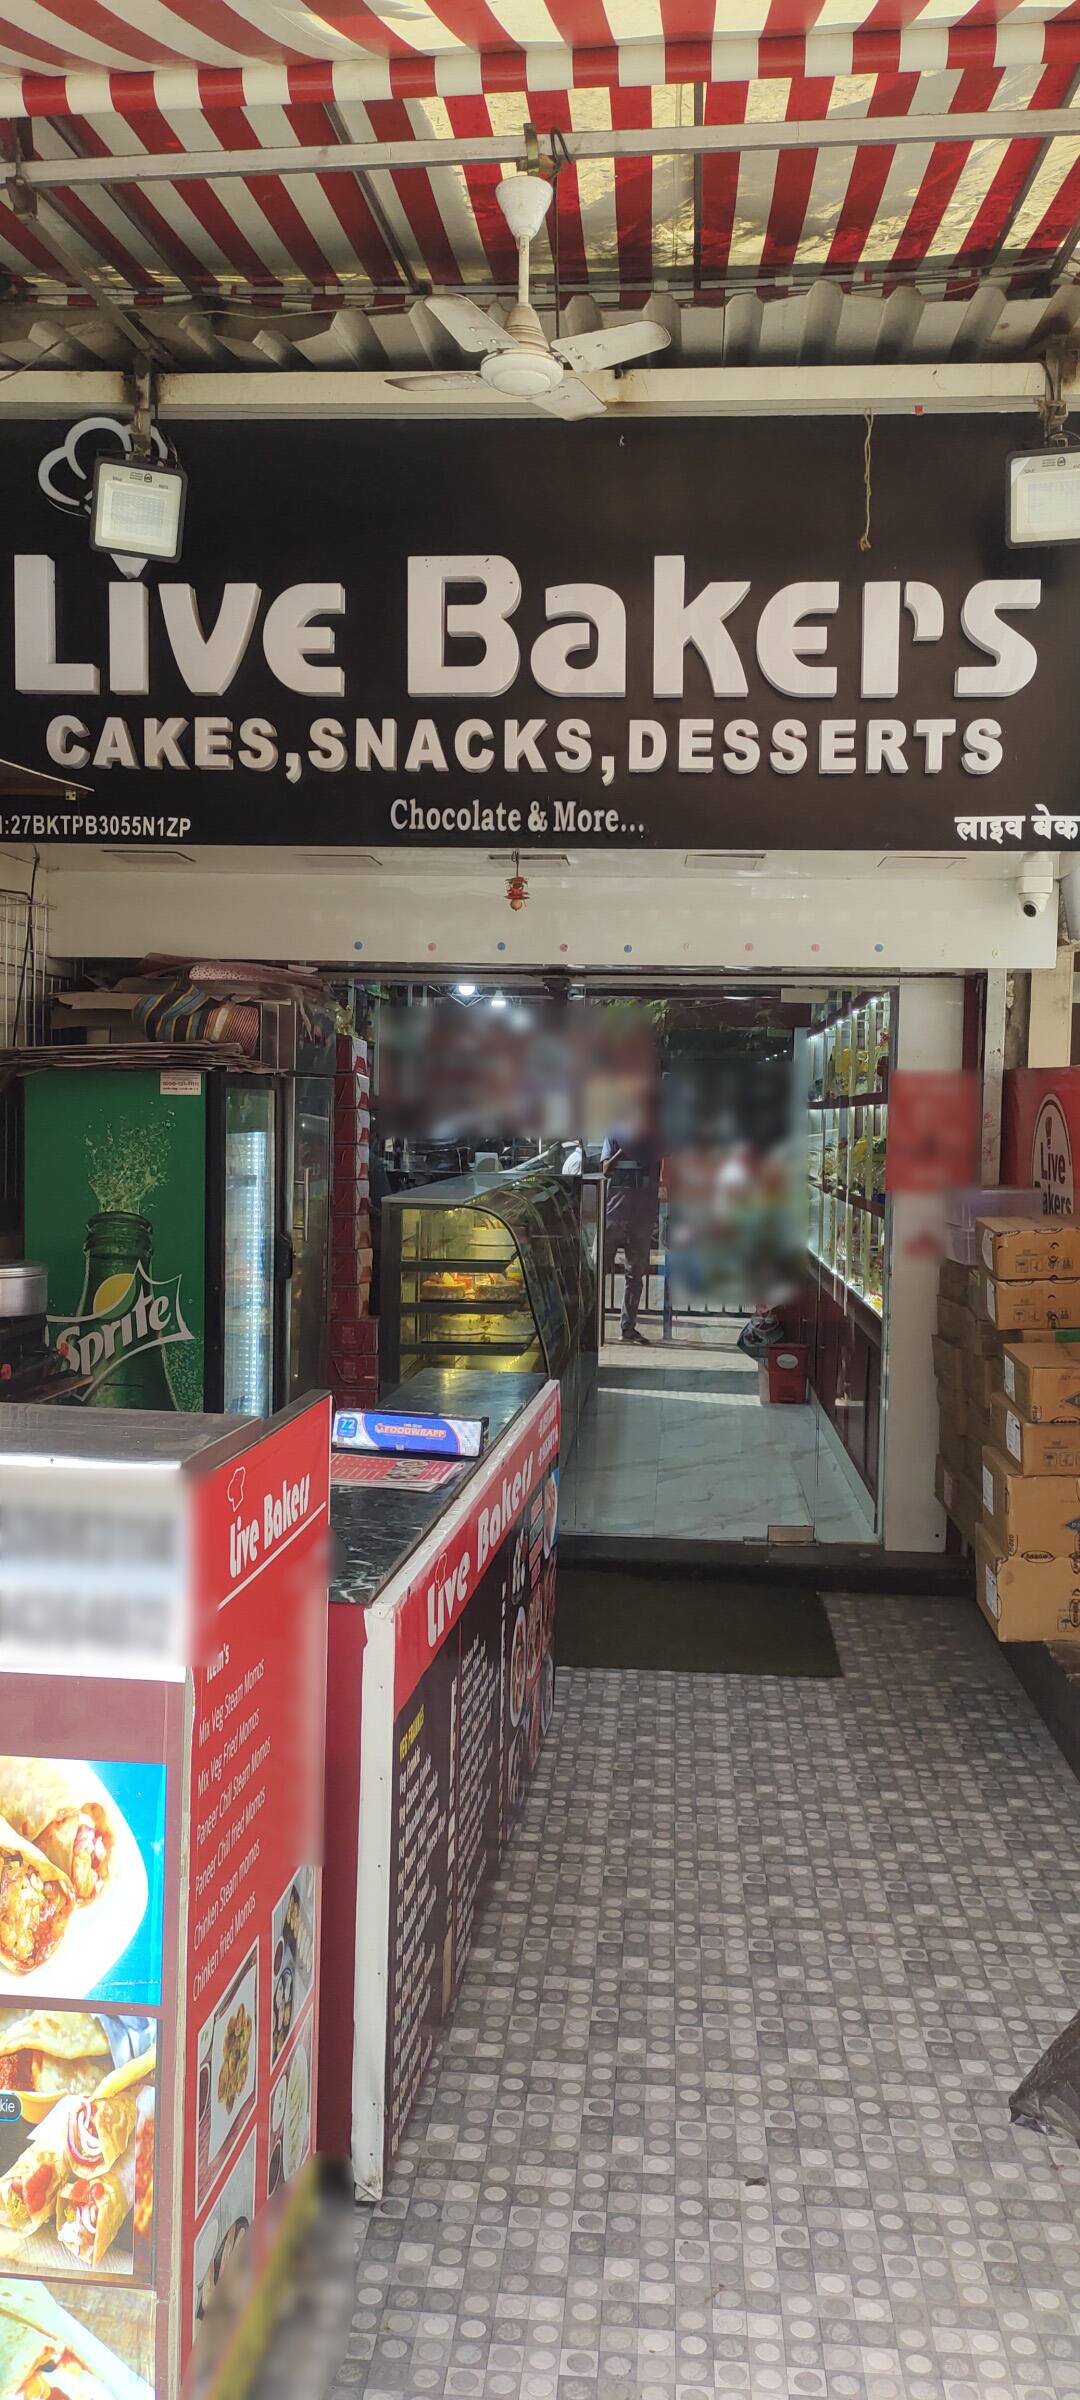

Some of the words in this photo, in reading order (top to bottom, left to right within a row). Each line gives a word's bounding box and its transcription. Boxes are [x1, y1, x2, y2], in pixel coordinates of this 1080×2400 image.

[14, 554, 346, 697] Live
[408, 554, 1042, 698] Bakers
[0, 815, 192, 838] :27BKTPB3055N1ZP
[390, 798, 521, 832] Chocolate
[527, 800, 549, 832] &
[553, 800, 646, 833] More...
[954, 815, 1026, 845] लाइव
[1040, 1142, 1066, 1185] Live
[1034, 1181, 1072, 1217] akers
[56, 1284, 172, 1376] Sprite
[230, 1515, 260, 1578] Live
[263, 1473, 310, 1550] Bakers
[427, 1552, 471, 1648] Live
[476, 1452, 534, 1573] Bakers
